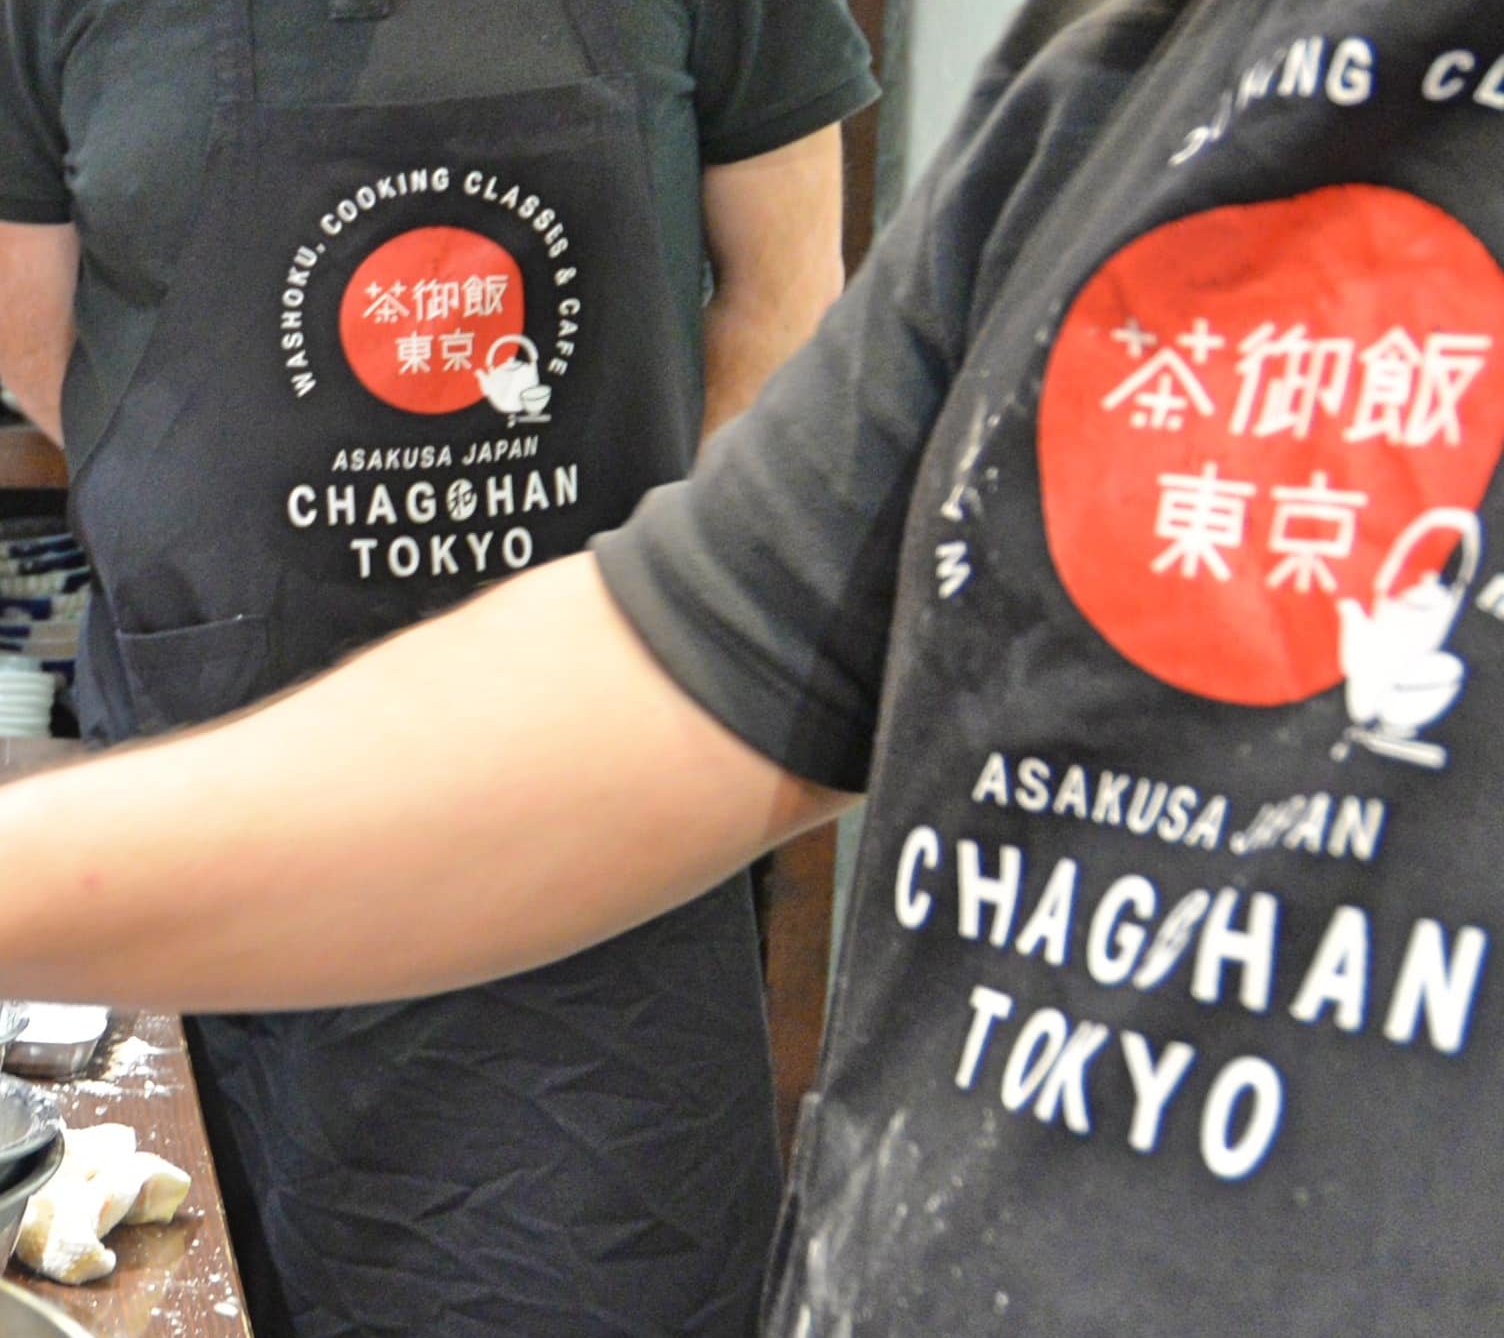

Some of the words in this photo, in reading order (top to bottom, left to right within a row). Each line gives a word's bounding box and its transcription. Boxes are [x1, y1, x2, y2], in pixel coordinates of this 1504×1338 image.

[319, 168, 451, 236] COOKING
[463, 170, 569, 261] CLASSES
[361, 273, 510, 325] 茶御飯
[553, 266, 579, 289] &
[394, 329, 477, 375] 東京
[546, 298, 581, 378] CAFE
[1100, 315, 1494, 449] 茶御飯
[331, 445, 454, 473] ASAKUSA
[461, 435, 540, 467] JAPAN
[351, 526, 534, 580] TOKYO
[1150, 461, 1369, 595] 東京
[972, 751, 1231, 851] ASAKUSA
[954, 983, 1285, 1181] TOKYO
